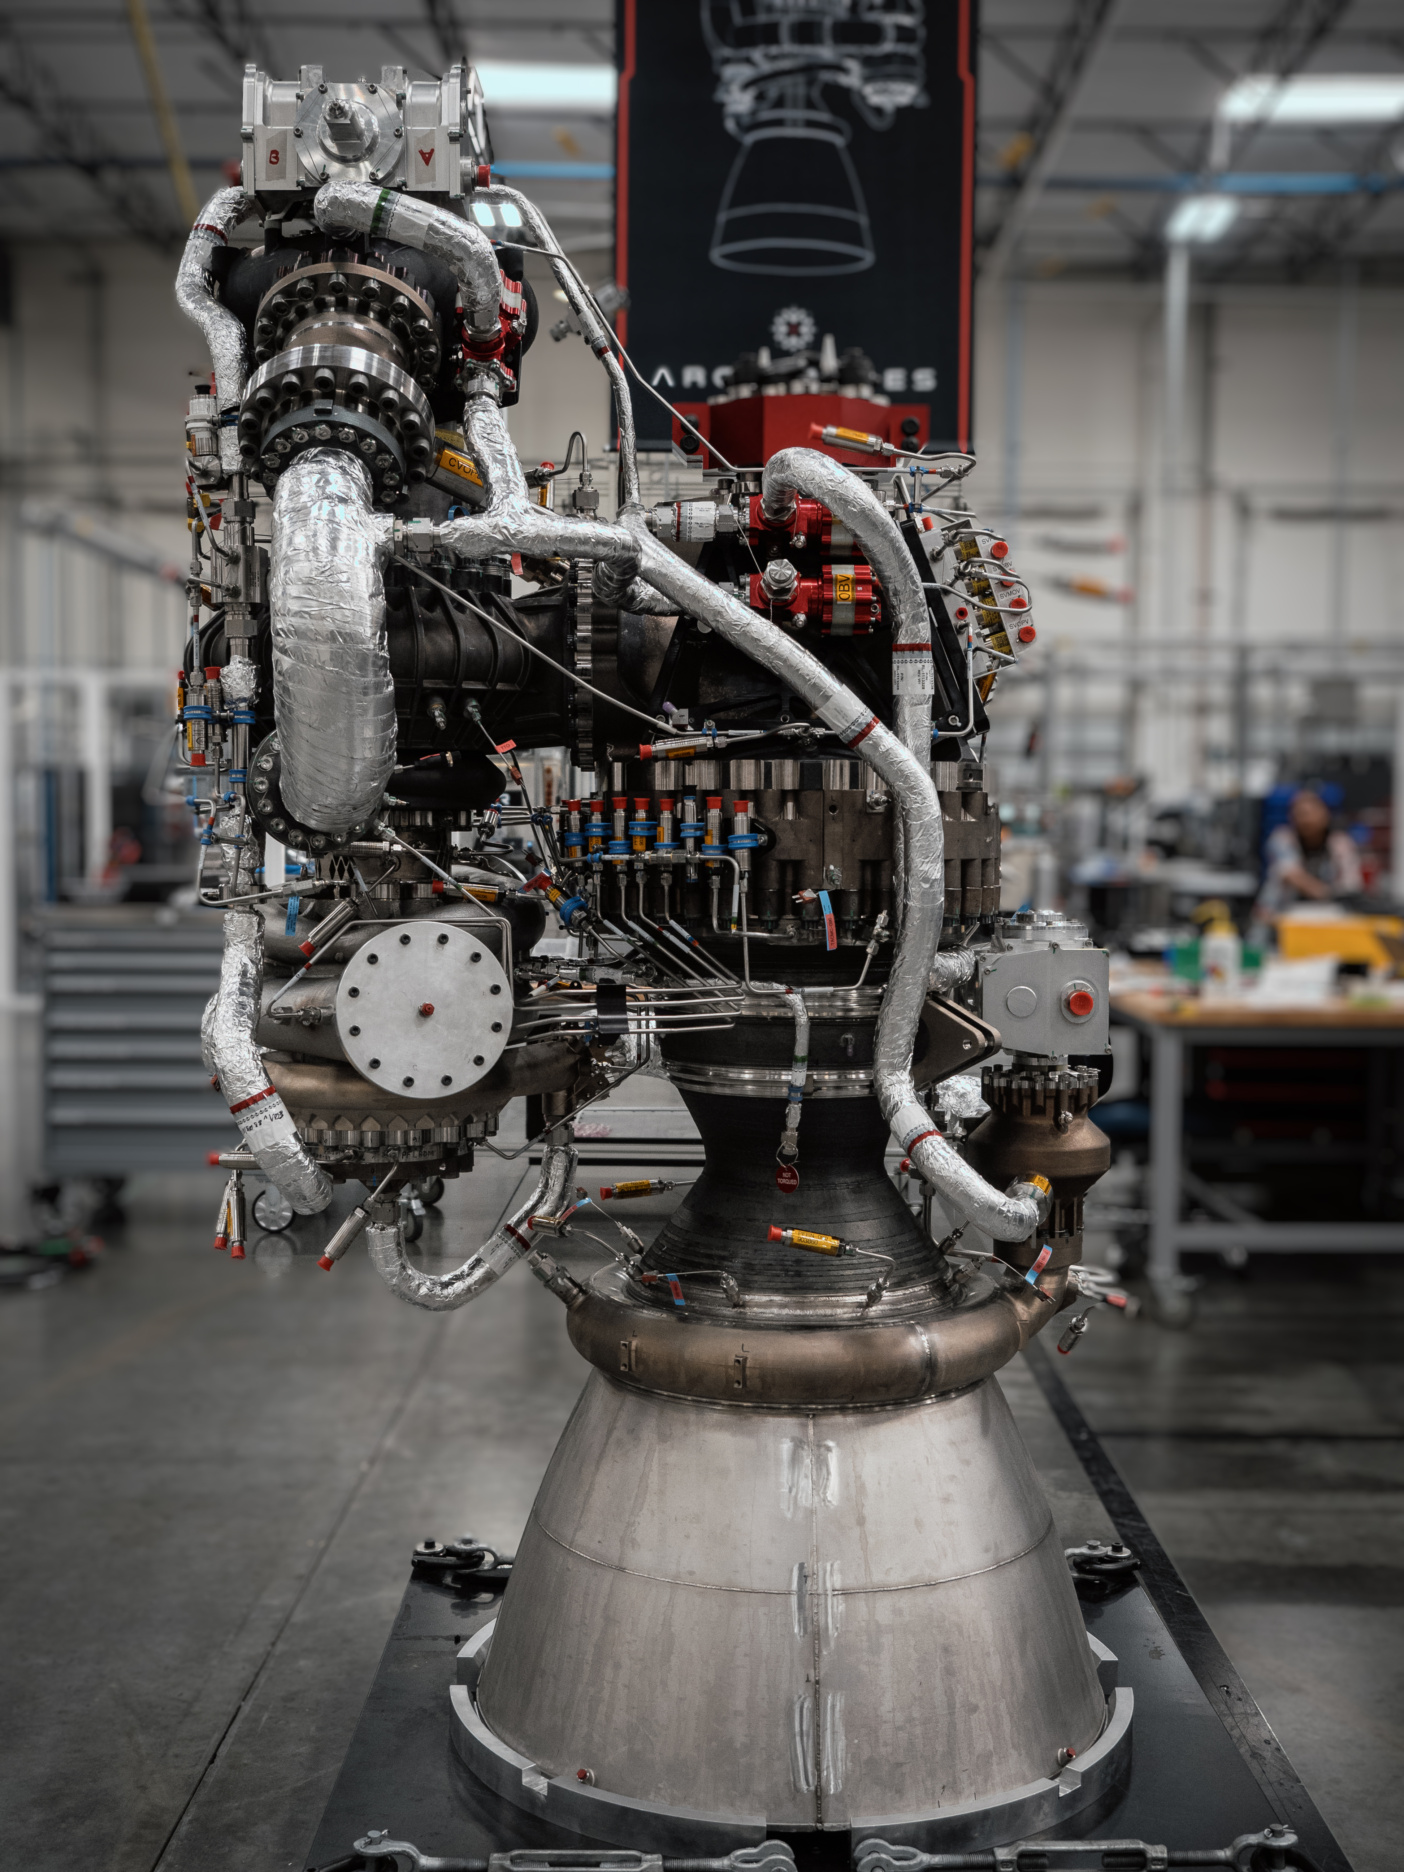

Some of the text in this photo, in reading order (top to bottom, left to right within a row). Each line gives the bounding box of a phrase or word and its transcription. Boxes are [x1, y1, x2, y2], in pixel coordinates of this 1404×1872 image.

[269, 149, 280, 165] B
[418, 148, 435, 167] A
[838, 574, 851, 601] OBV
[999, 588, 1021, 600] SVMOV
[777, 1177, 798, 1186] TORQUED
